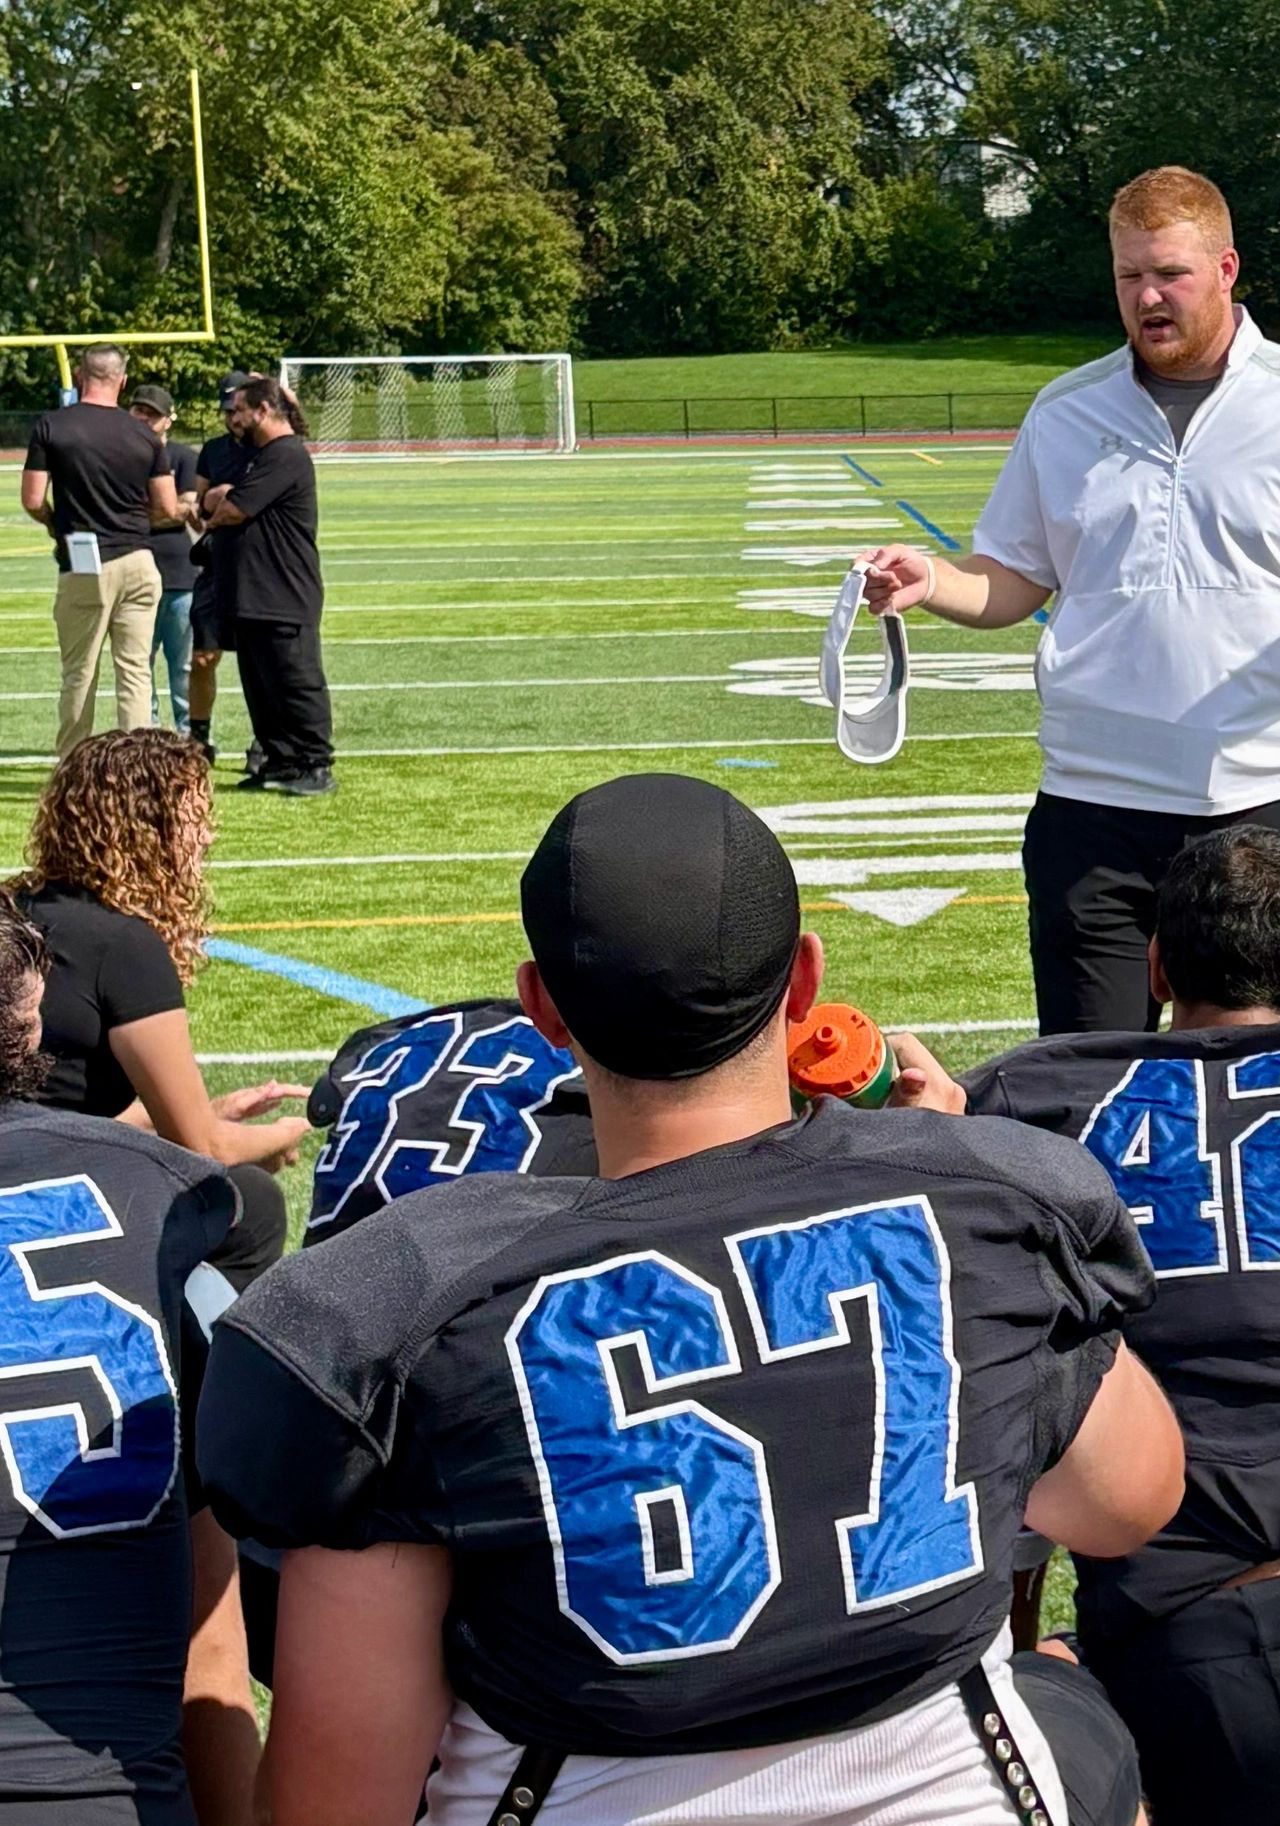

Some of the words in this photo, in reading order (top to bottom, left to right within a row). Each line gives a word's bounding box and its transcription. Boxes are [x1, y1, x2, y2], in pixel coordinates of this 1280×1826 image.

[308, 1011, 582, 1228] 33
[0, 1173, 180, 1539] 5
[504, 1194, 984, 1665] 67
